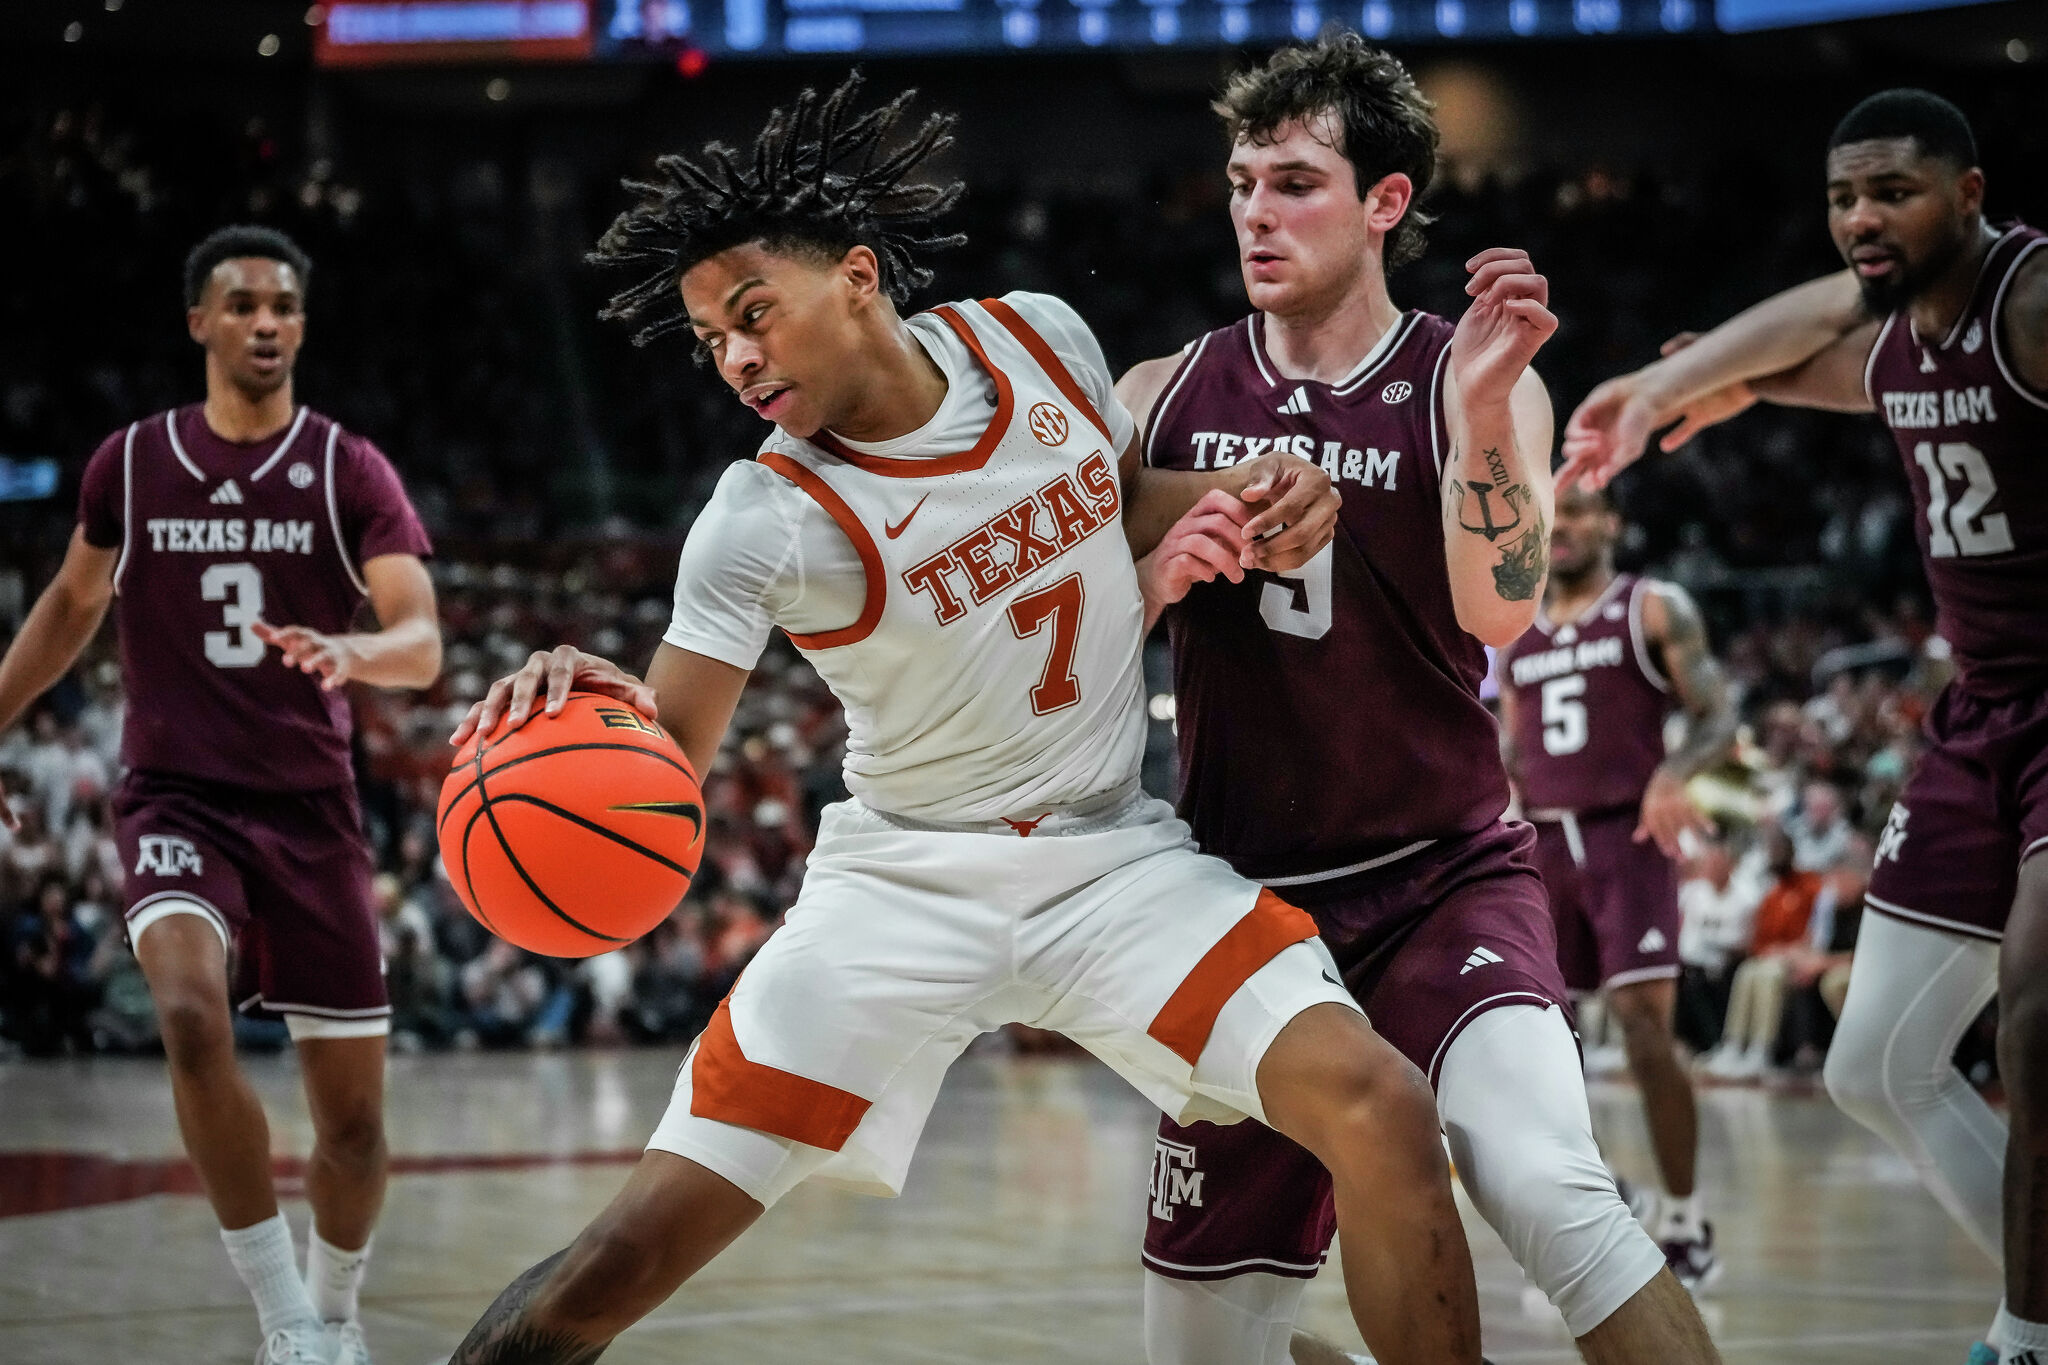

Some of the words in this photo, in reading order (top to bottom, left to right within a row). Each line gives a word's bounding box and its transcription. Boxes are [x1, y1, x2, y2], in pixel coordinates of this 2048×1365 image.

[1030, 403, 1067, 445] SEC
[1382, 382, 1411, 403] SEC
[1882, 391, 1939, 428] TEXAS
[1320, 441, 1401, 491] A&M
[1914, 441, 2015, 558] 12
[147, 518, 246, 552] TEXAS
[251, 518, 314, 555] A&M
[902, 449, 1120, 626] TEXAS
[201, 562, 266, 669] 3
[1006, 572, 1085, 716] 7
[1541, 673, 1589, 757] 5
